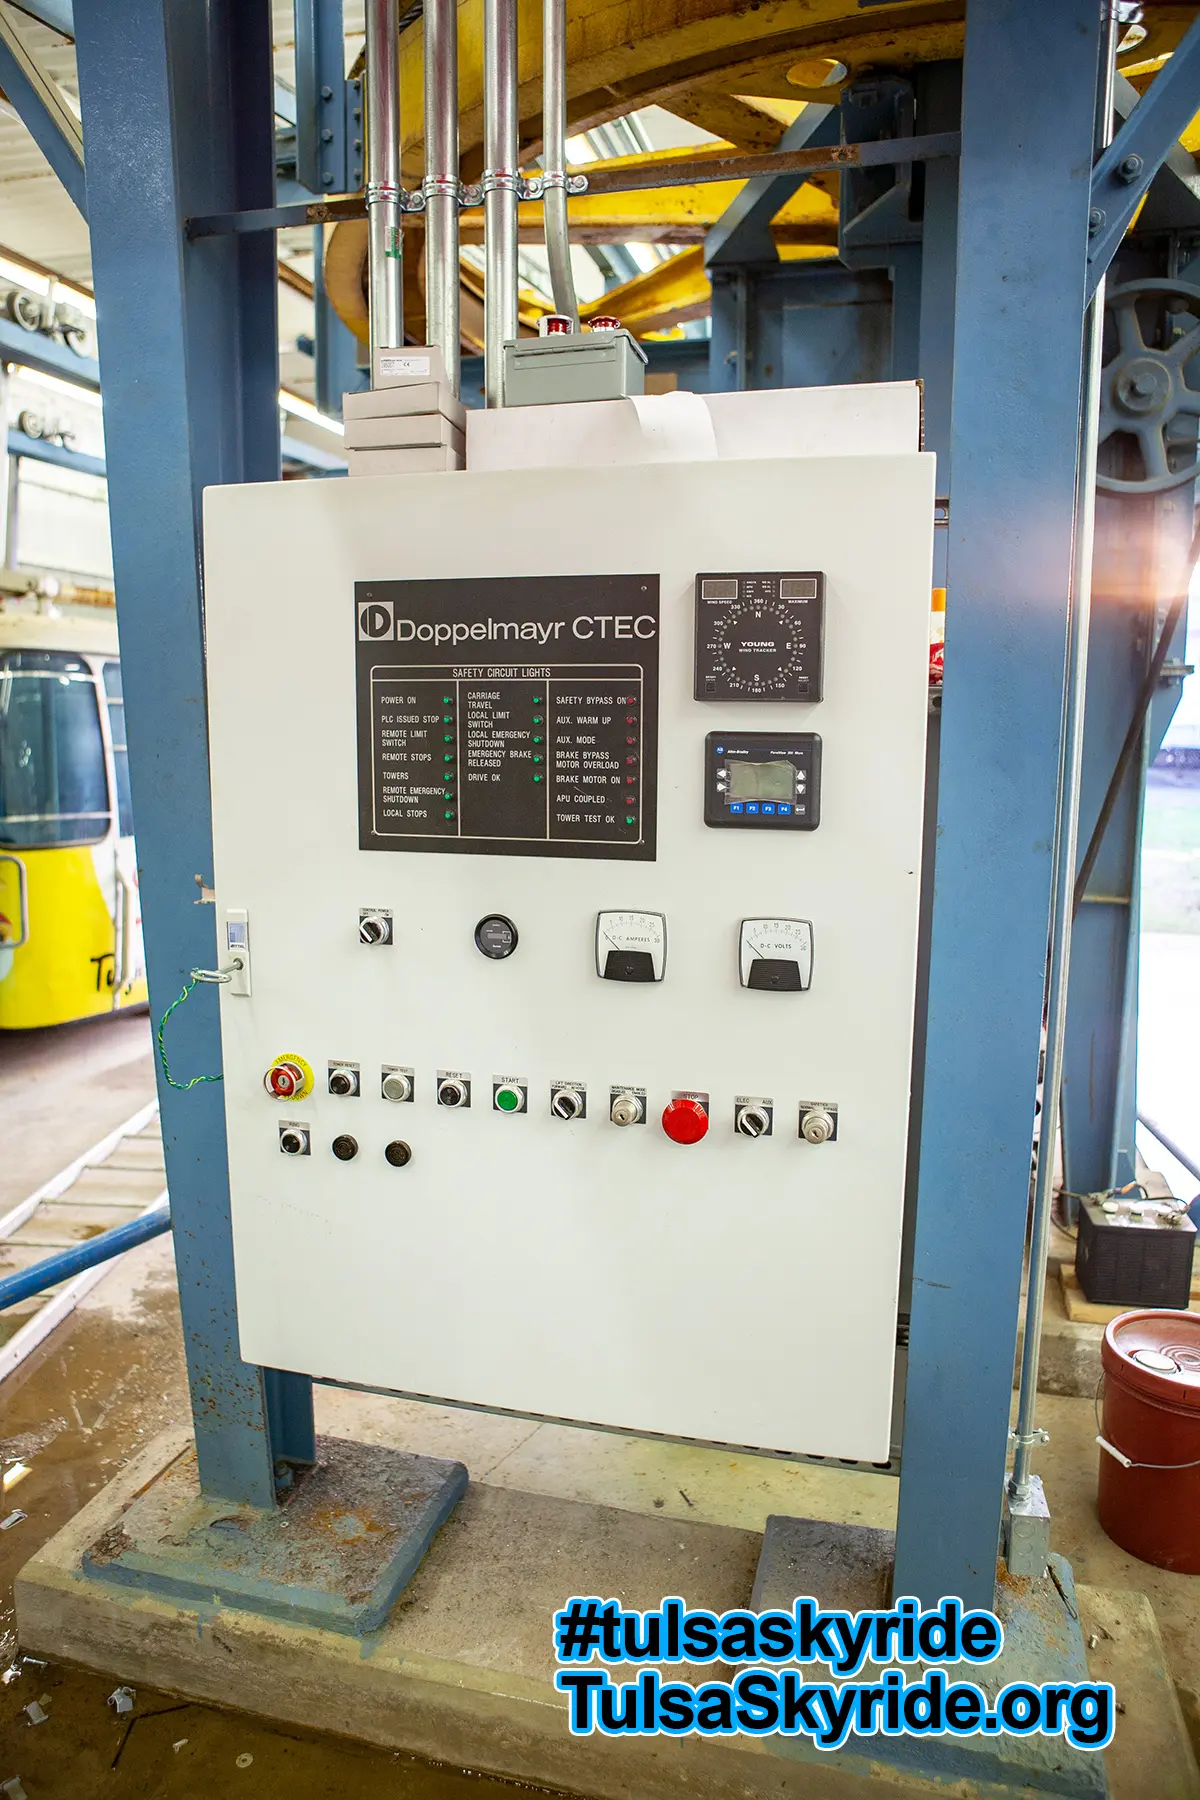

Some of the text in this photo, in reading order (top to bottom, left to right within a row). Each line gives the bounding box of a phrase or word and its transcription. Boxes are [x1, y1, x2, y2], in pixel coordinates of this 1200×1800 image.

[397, 615, 656, 645] Doppelmayr CTEC
[452, 667, 551, 678] SAFETY CIRCUIT LIGHTS
[380, 696, 416, 704] POWER ON
[467, 692, 500, 700] CARRIAGE
[556, 696, 583, 704] SAFETY
[586, 697, 613, 705] BYPASS
[468, 701, 492, 709] TRAVEL
[381, 715, 440, 723] PLC ISSUED STOP
[467, 711, 510, 719] LOCAL LIMIT
[556, 716, 573, 724] AUX.
[576, 716, 598, 724] WARM
[381, 730, 407, 738] REMOTE
[492, 731, 531, 739] EMERGENCY
[382, 739, 407, 747] SWITCH
[467, 740, 505, 748] SHUTDOWN
[556, 736, 596, 744] AUX. MODE
[381, 753, 407, 761] REMOTE
[468, 750, 532, 758] EMERGENCY BRAKE
[556, 751, 610, 760] BRAKE BYPASS
[468, 759, 501, 767] RELEASED
[583, 761, 619, 769] OVERLOAD
[382, 772, 409, 780] TOWERS
[556, 775, 620, 784] BRAKE MOTOR ON
[382, 786, 445, 795] REMOTE EMERGENCY
[383, 795, 419, 803] SHUTDOWN
[574, 795, 605, 803] COUPLED
[383, 809, 427, 818] LOCAL STOPS
[556, 814, 615, 823] TOWER TEST OK
[275, 1054, 307, 1067] EMERGENCY
